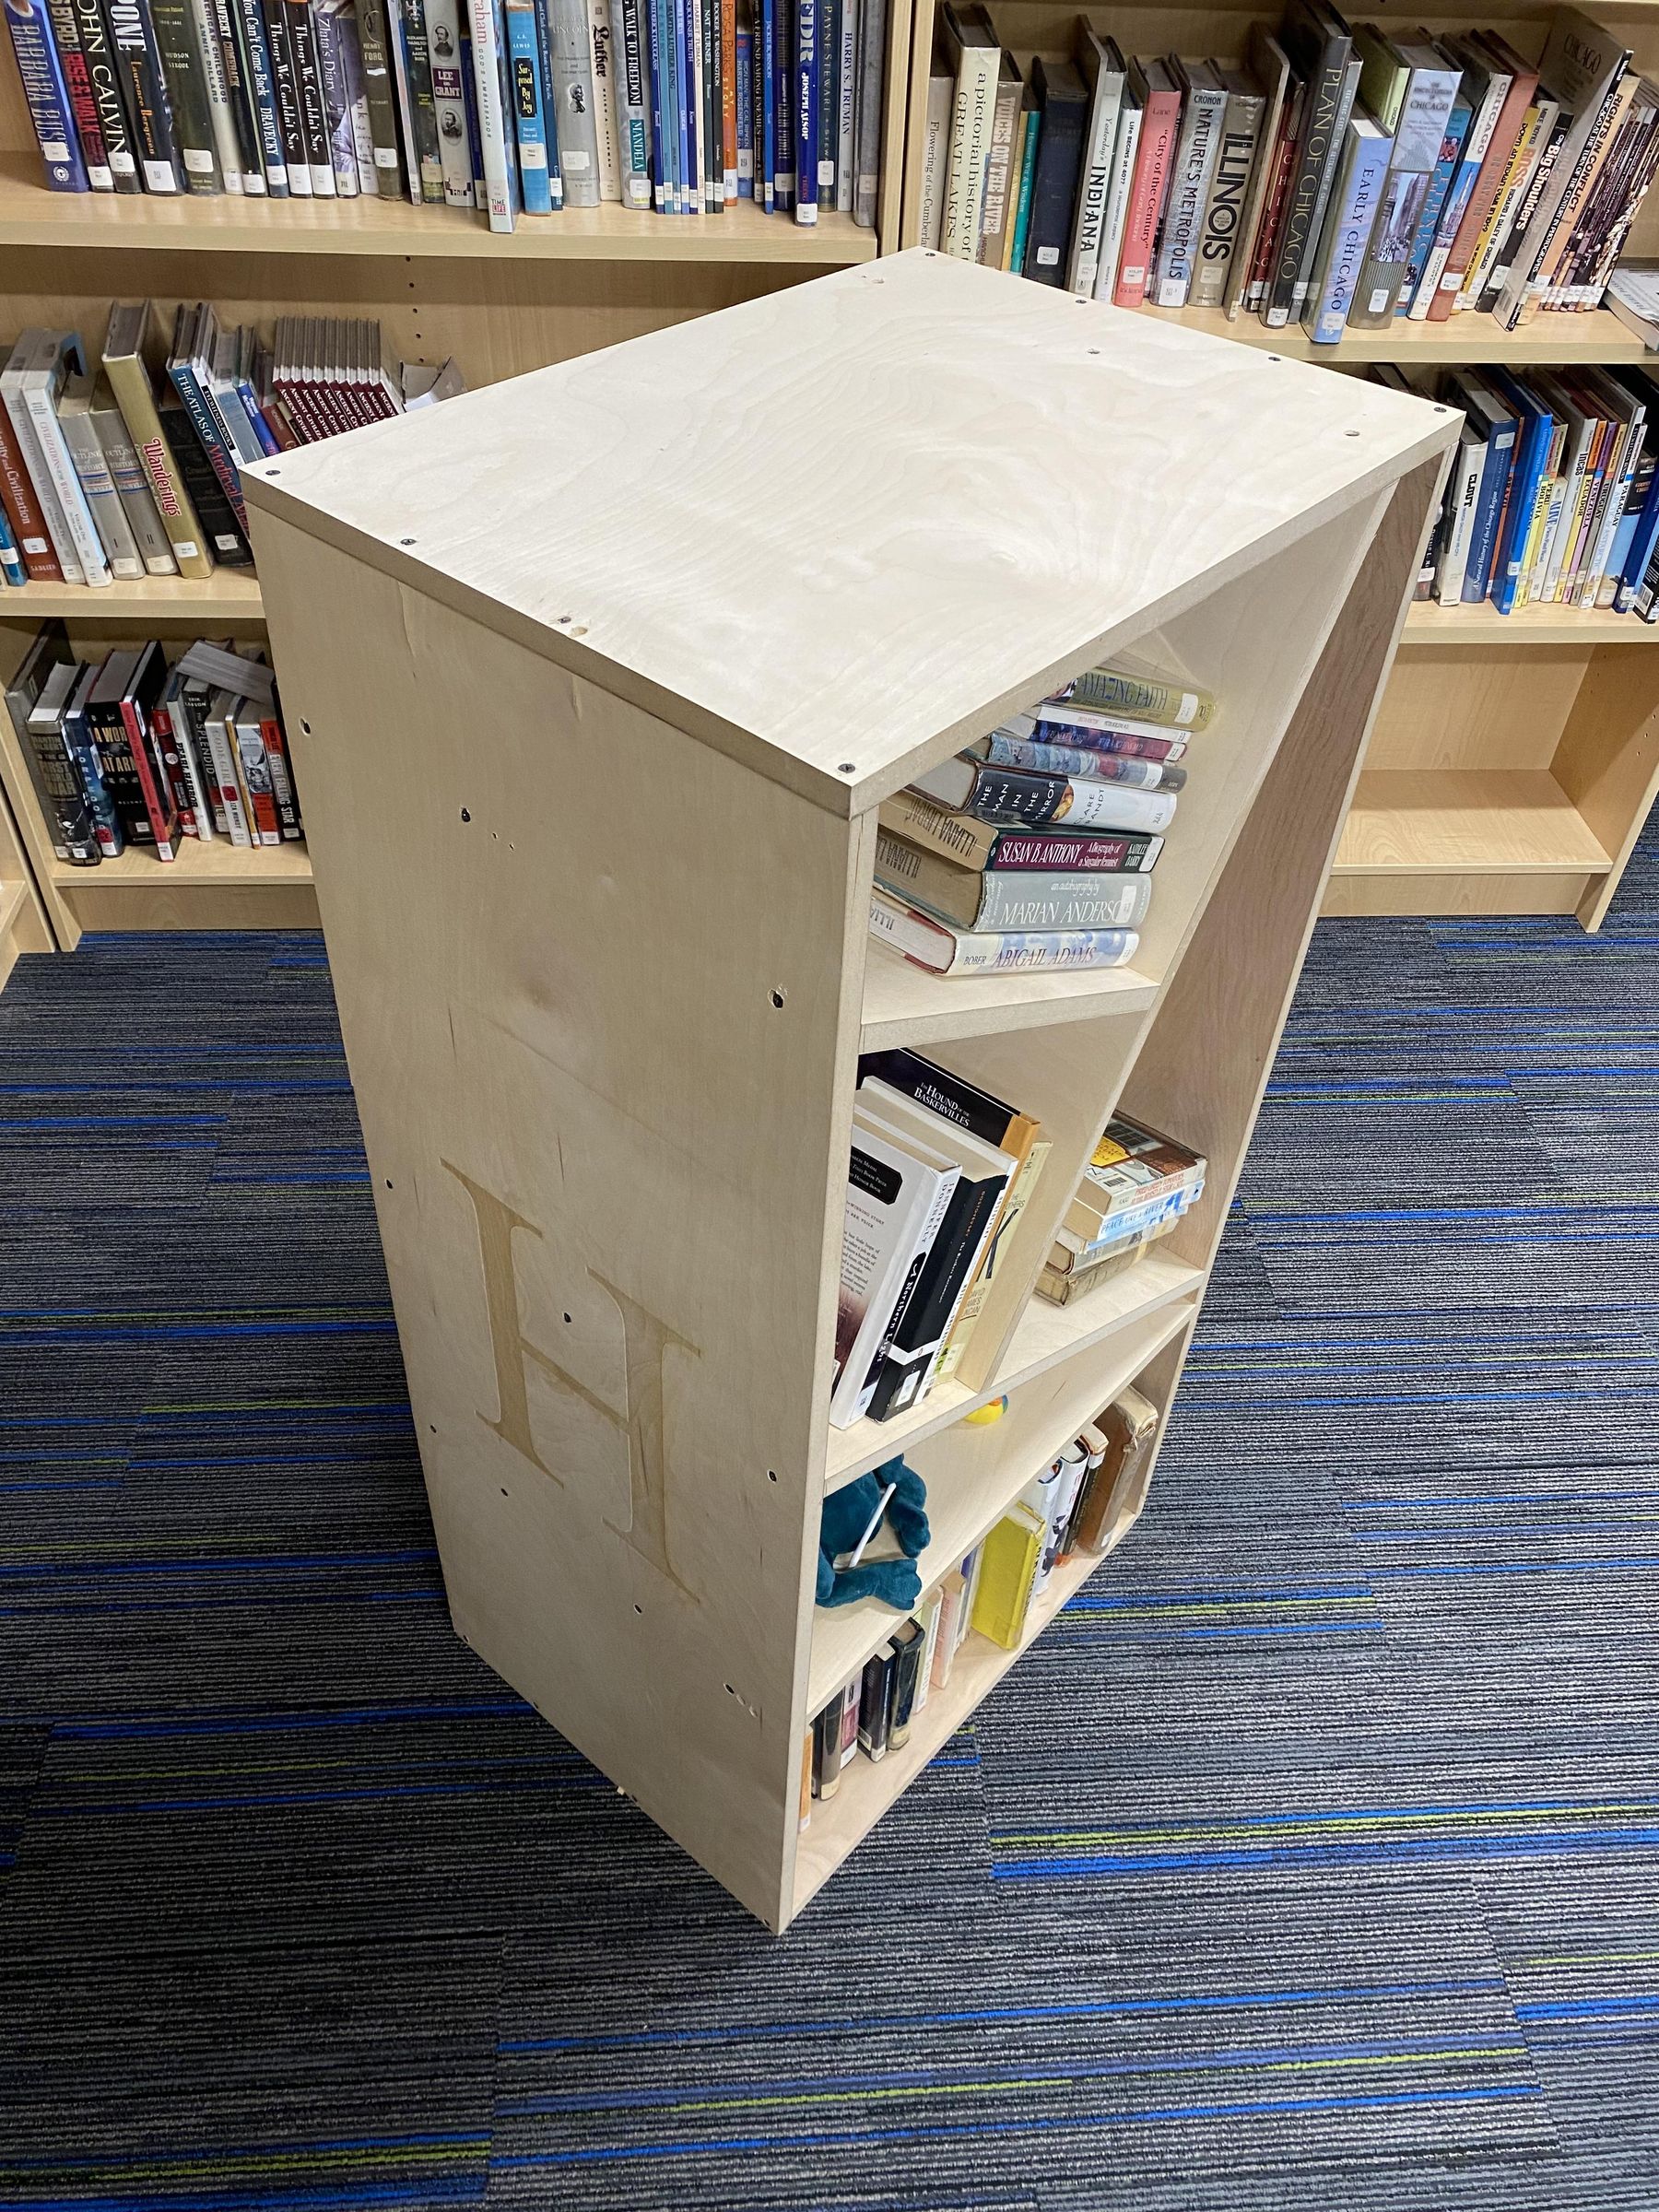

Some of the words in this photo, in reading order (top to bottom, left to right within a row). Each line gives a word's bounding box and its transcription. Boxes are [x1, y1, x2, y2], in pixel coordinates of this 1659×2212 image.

[51, 6, 79, 44] BYRD
[246, 17, 261, 42] Can't
[624, 8, 638, 36] WALK
[722, 3, 734, 36] ROSA
[800, 0, 815, 63] FDR
[824, 6, 833, 49] PAYNE
[270, 22, 284, 63] Things
[295, 23, 308, 68] Things
[318, 18, 332, 57] Zlata's
[593, 24, 610, 78] Luther
[627, 37, 638, 54] TO
[704, 30, 712, 64] TURNER
[754, 26, 762, 60] FRIEND
[843, 32, 853, 67] HARRY
[10, 24, 55, 102] BARBARA
[199, 23, 210, 53] ANNIE
[206, 60, 219, 103] DILLARD
[251, 45, 264, 72] Come
[276, 64, 289, 80] We
[301, 66, 314, 82] We
[713, 40, 722, 87] WASHINGTON
[723, 40, 735, 74] PARKS
[212, 47, 228, 103] CHILDHOOD
[254, 73, 270, 97] Back
[324, 61, 336, 93] Diary
[434, 87, 462, 97] GRANT
[437, 70, 453, 81] LEE
[628, 56, 641, 105] FREEDOM
[755, 61, 763, 94] AMONG
[824, 53, 832, 112] STEWART
[978, 72, 988, 84] a
[62, 53, 88, 82] RISE
[75, 96, 101, 134] WALK
[91, 65, 127, 154] CALVIN
[131, 61, 145, 106] Laurence
[141, 109, 155, 155] Bergreen
[278, 84, 298, 128] Couldn't
[304, 84, 323, 131] Couldn't
[521, 88, 532, 100] By
[521, 104, 533, 114] Joy
[842, 85, 853, 135] TRUMAN
[1194, 95, 1222, 105] CRONON
[1313, 68, 1343, 130] PLAN
[1409, 101, 1450, 111] CHICAGO
[1595, 93, 1615, 126] CHICAGO
[260, 107, 279, 156] DRAVECKY
[953, 90, 969, 164] GREAT
[970, 86, 987, 167] pictorial
[993, 96, 1016, 148] VOICES
[1389, 106, 1399, 126] CHICAGO
[1477, 81, 1508, 155] CHICAGO
[1540, 107, 1549, 125] MIKE
[1599, 93, 1624, 139] RIGHTS
[287, 131, 300, 152] Say
[310, 133, 324, 153] Say
[632, 121, 646, 171] MANDELA
[924, 121, 941, 174] Flowering
[990, 145, 1010, 165] ON
[1124, 135, 1134, 159] BEGINS
[1187, 108, 1215, 182] NATURE'S
[1306, 135, 1327, 169] OF
[1539, 144, 1561, 169] Big
[1592, 140, 1605, 154] IN
[925, 174, 934, 183] of
[987, 165, 1007, 194] THE
[1149, 172, 1160, 192] the
[1510, 147, 1535, 188] BOSS
[1568, 155, 1598, 214] CONFLICT
[924, 183, 934, 196] the
[947, 171, 961, 239] LAKES
[963, 169, 980, 235] history
[1202, 133, 1255, 262] ILLINOIS
[1351, 169, 1375, 224] EARLY
[1515, 167, 1549, 231] Shoulders
[983, 194, 1004, 236] RIVER
[1079, 165, 1106, 253] INDIANA
[1169, 186, 1199, 279] METROPOLIS
[1280, 173, 1318, 280] CHICAGO
[960, 237, 971, 253] of
[1531, 226, 1558, 275] PHOTOGRAPHS
[1330, 230, 1359, 312] CHICAGO
[177, 373, 193, 394] THE
[289, 387, 309, 414] ANCIENT
[185, 394, 208, 428] ATLAS
[279, 388, 297, 415] ANCIENT
[300, 388, 320, 415] ANCIENT
[312, 388, 331, 415] ANCIENT
[324, 388, 342, 415] ANCIENT
[200, 428, 216, 444] OF
[142, 437, 182, 518] Wanderings
[206, 444, 243, 499] Medieval
[1575, 453, 1589, 477] Incas
[6, 468, 31, 524] Civilization
[1463, 473, 1478, 508] CLOUT
[1534, 485, 1547, 520] BOLIVIA
[1544, 482, 1555, 505] PERU
[1577, 478, 1592, 518] ECUADOR
[1582, 481, 1600, 530] VENEZUELA
[1594, 482, 1610, 520] URUGUAY
[1611, 484, 1630, 527] PARAGUAY
[1137, 687, 1169, 710] FAITH
[195, 723, 216, 775] SPLENDID
[269, 753, 282, 778] EVERY
[175, 742, 189, 773] PEARL
[182, 772, 199, 809] HARBOR
[275, 777, 293, 806] FALLING
[977, 784, 993, 806] THE
[992, 783, 1009, 813] MAN
[1011, 794, 1023, 808] IN
[1024, 791, 1039, 813] THE
[1073, 792, 1095, 826] CLARE
[280, 806, 296, 825] STAR
[937, 816, 978, 858] ILLIANA
[998, 841, 1033, 864] SUSAN
[1040, 842, 1084, 864] ANTHONY
[885, 841, 922, 878] ILLIANA
[1050, 883, 1060, 891] an
[1059, 878, 1092, 897] autobiography
[1091, 881, 1100, 897] by
[999, 900, 1060, 926] MARIAN
[963, 955, 987, 966] BOBER
[993, 948, 1047, 969] ABIGAIL
[1048, 946, 1098, 966] ADAMS
[913, 1087, 971, 1127] BASKERVILLES
[925, 1084, 959, 1111] HOUND
[921, 1183, 948, 1243] DONNELLY
[928, 1182, 956, 1240] JENNIFER
[1100, 1217, 1124, 1233] PEACE
[1143, 1201, 1165, 1216] RIVER
[910, 1263, 919, 1277] A
[889, 1281, 914, 1329] Northern
[877, 1333, 894, 1363] Light
[439, 1156, 703, 1606] H
